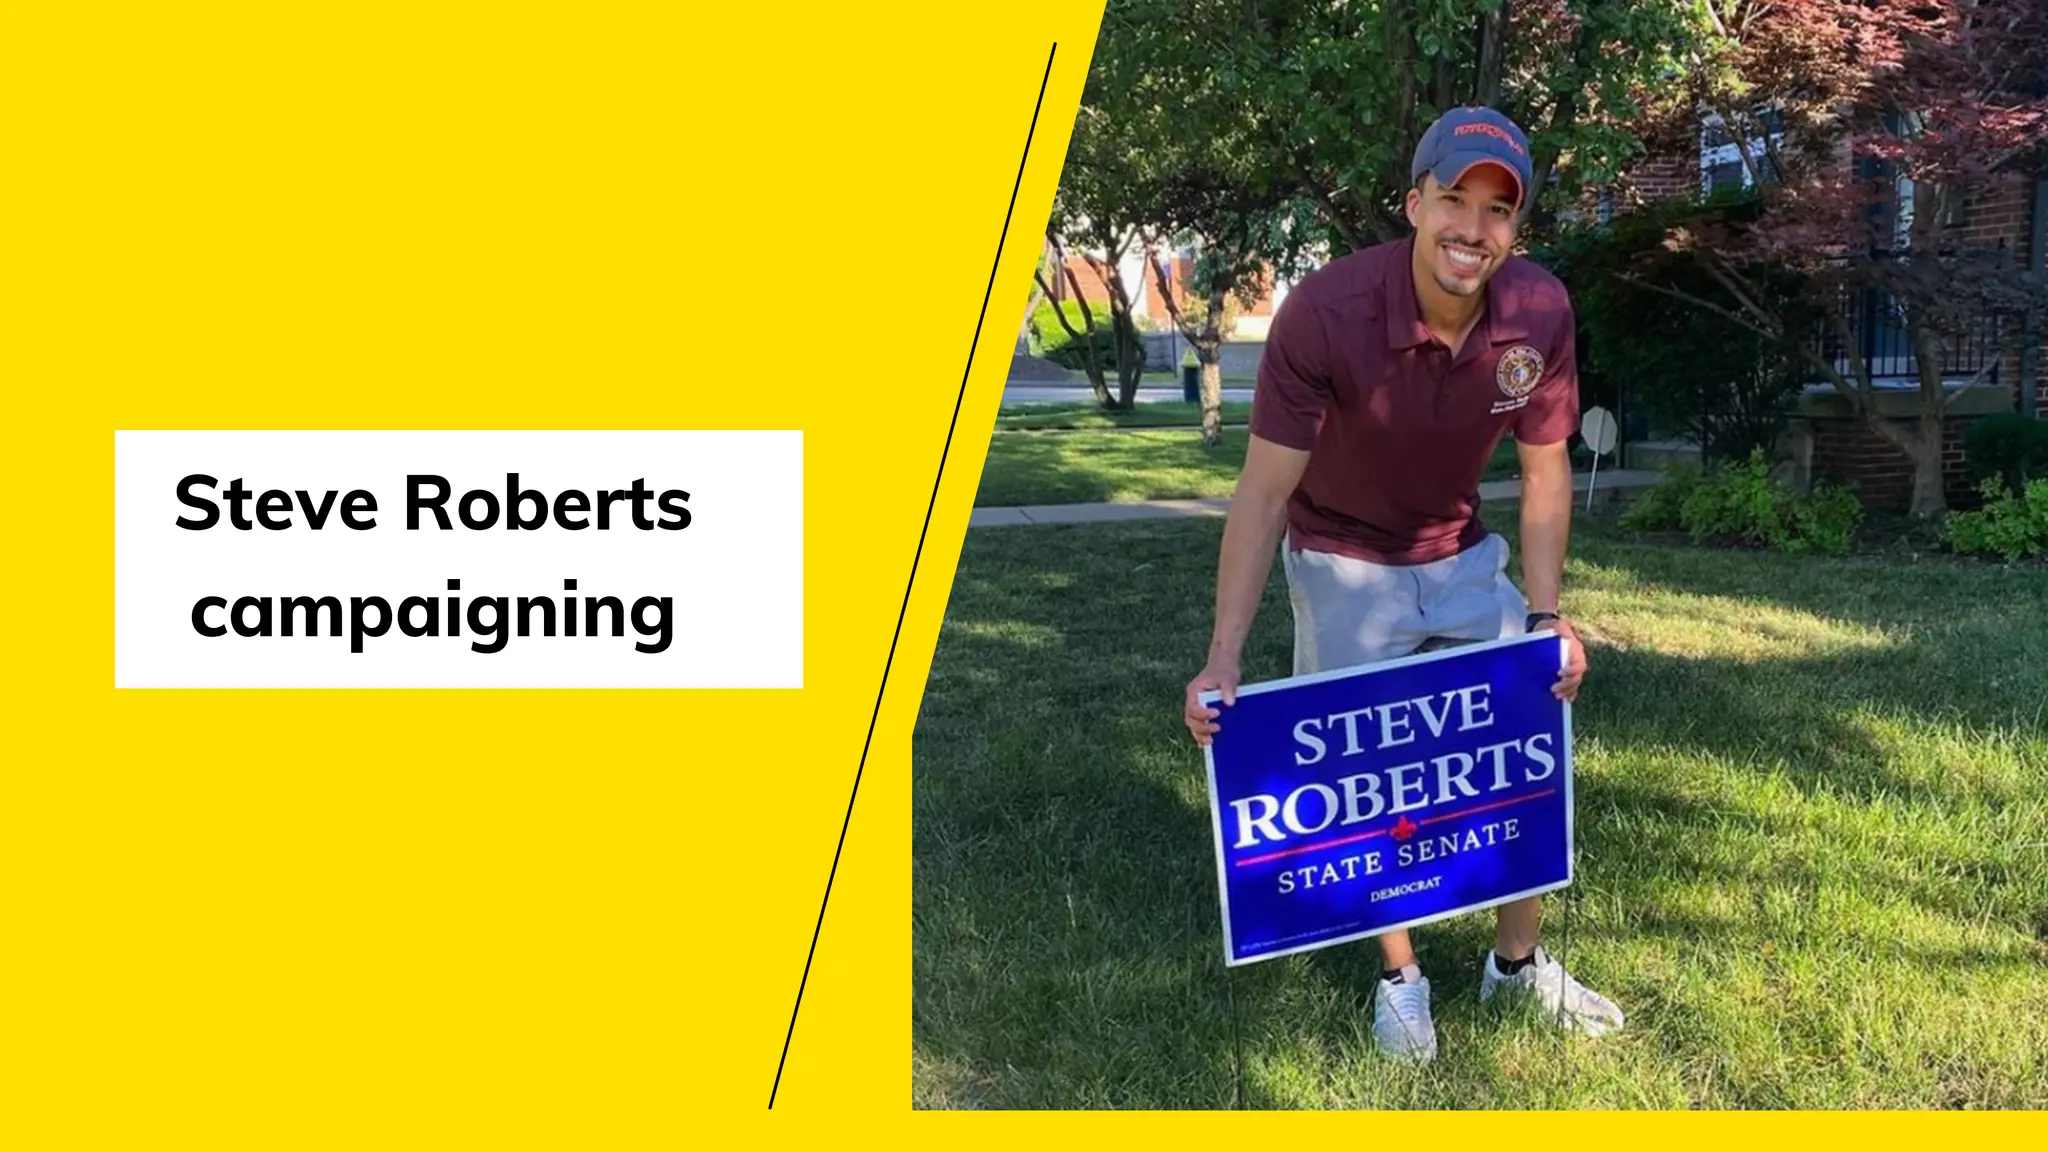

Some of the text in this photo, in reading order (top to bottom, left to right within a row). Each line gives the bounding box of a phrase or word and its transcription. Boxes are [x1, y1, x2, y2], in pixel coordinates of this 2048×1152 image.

[1292, 683, 1495, 766] STEVE
[1229, 732, 1556, 849] ROBERTS
[1278, 818, 1521, 894] STATE SENATE
[1370, 876, 1442, 903] DEMOCRAT
